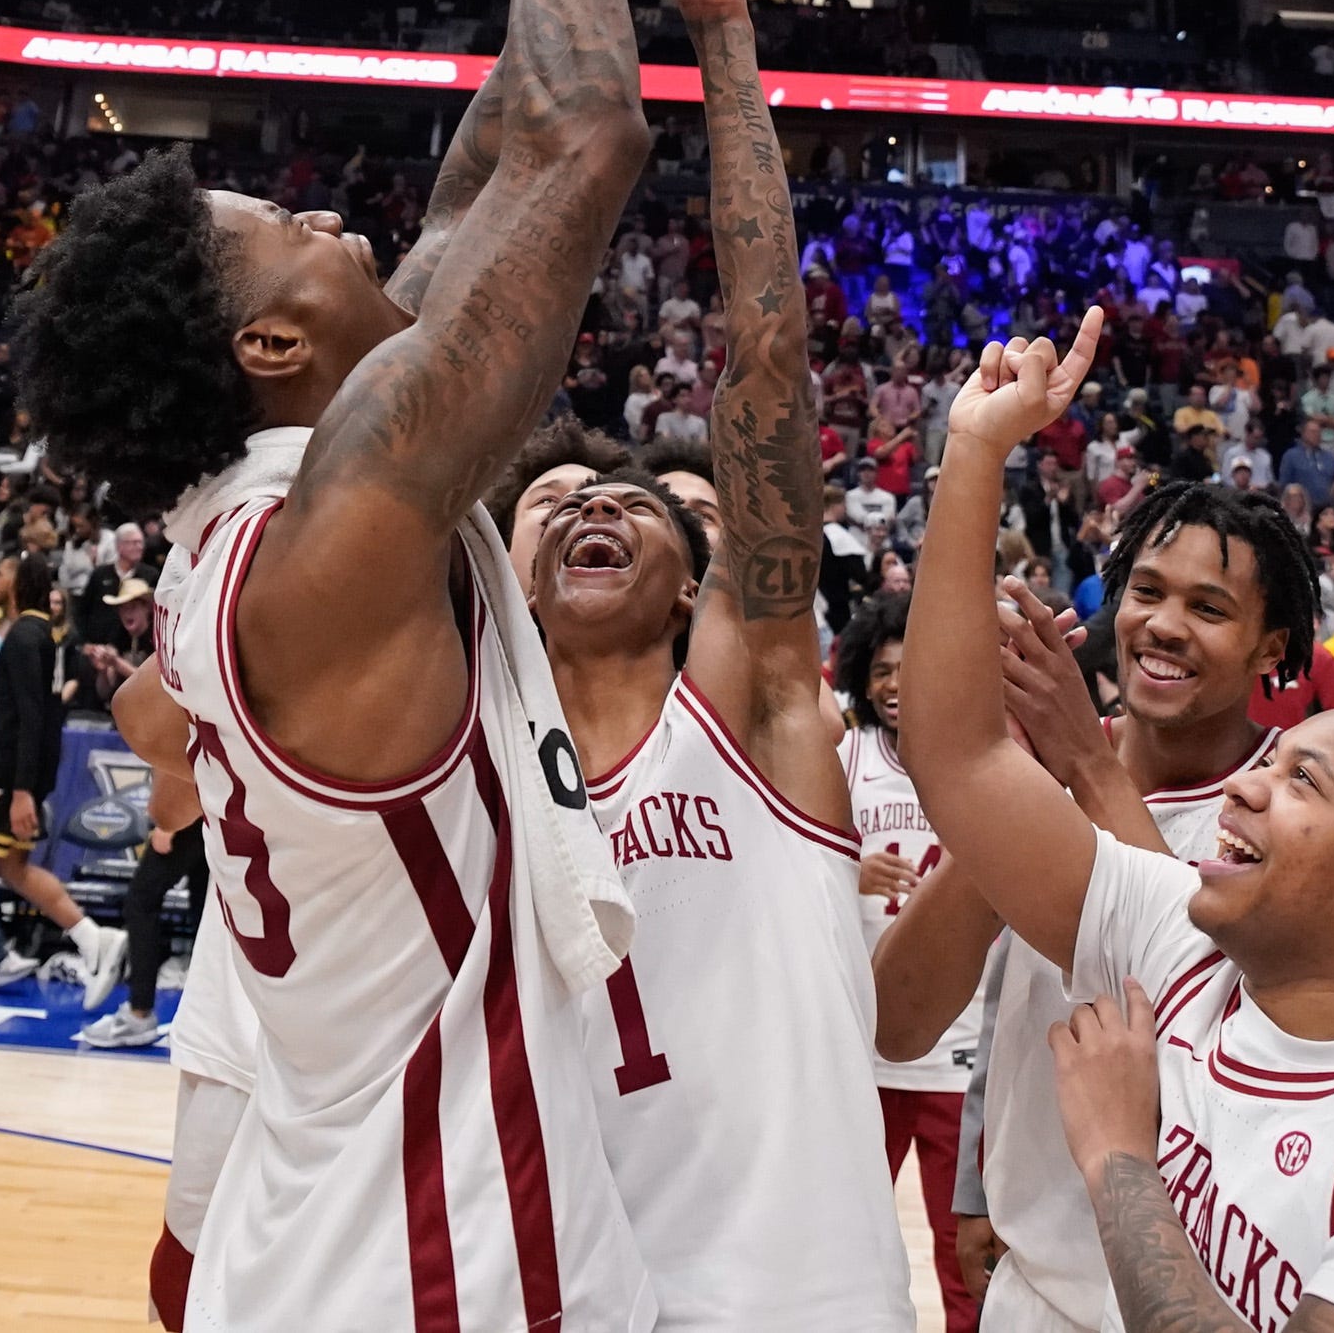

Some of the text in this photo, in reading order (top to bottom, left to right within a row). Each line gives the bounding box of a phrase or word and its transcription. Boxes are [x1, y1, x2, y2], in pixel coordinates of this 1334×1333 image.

[752, 139, 778, 175] the
[860, 802, 935, 837] RAZORB
[1276, 1132, 1310, 1174] SEC
